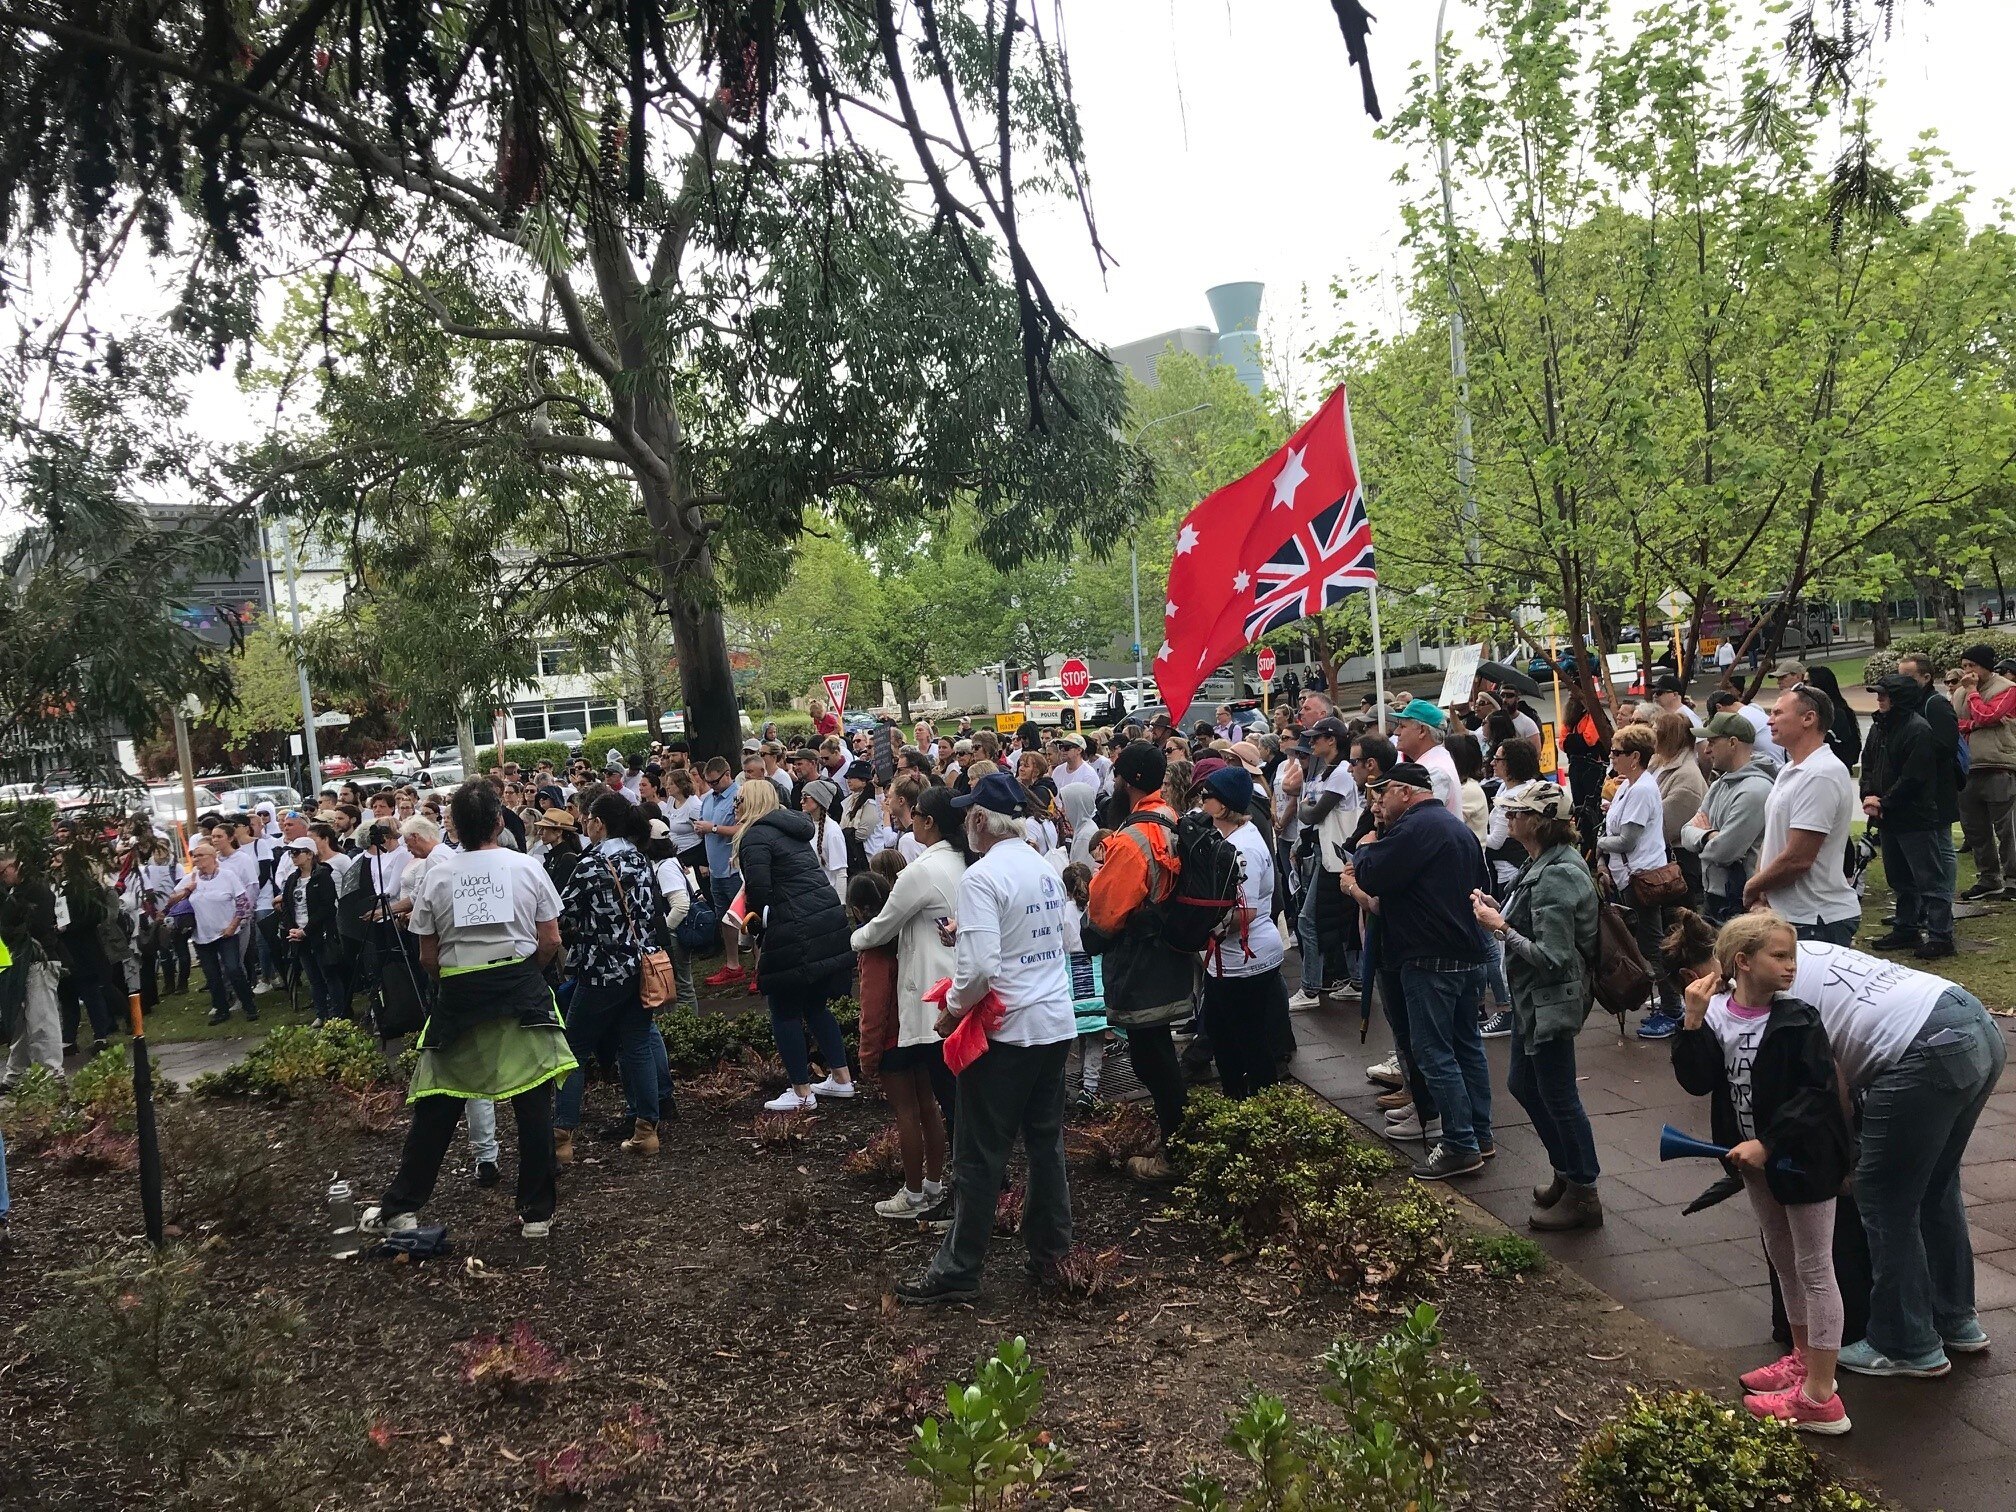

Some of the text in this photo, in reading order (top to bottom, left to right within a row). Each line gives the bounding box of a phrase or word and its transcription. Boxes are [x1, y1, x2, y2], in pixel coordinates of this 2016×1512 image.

[1259, 657, 1275, 672] STOP
[831, 681, 843, 690] GIVE
[1062, 670, 1087, 687] STOP
[1025, 902, 1041, 915] IT'S
[1031, 926, 1051, 939] TAKE
[1020, 949, 1058, 965] COUNTRY
